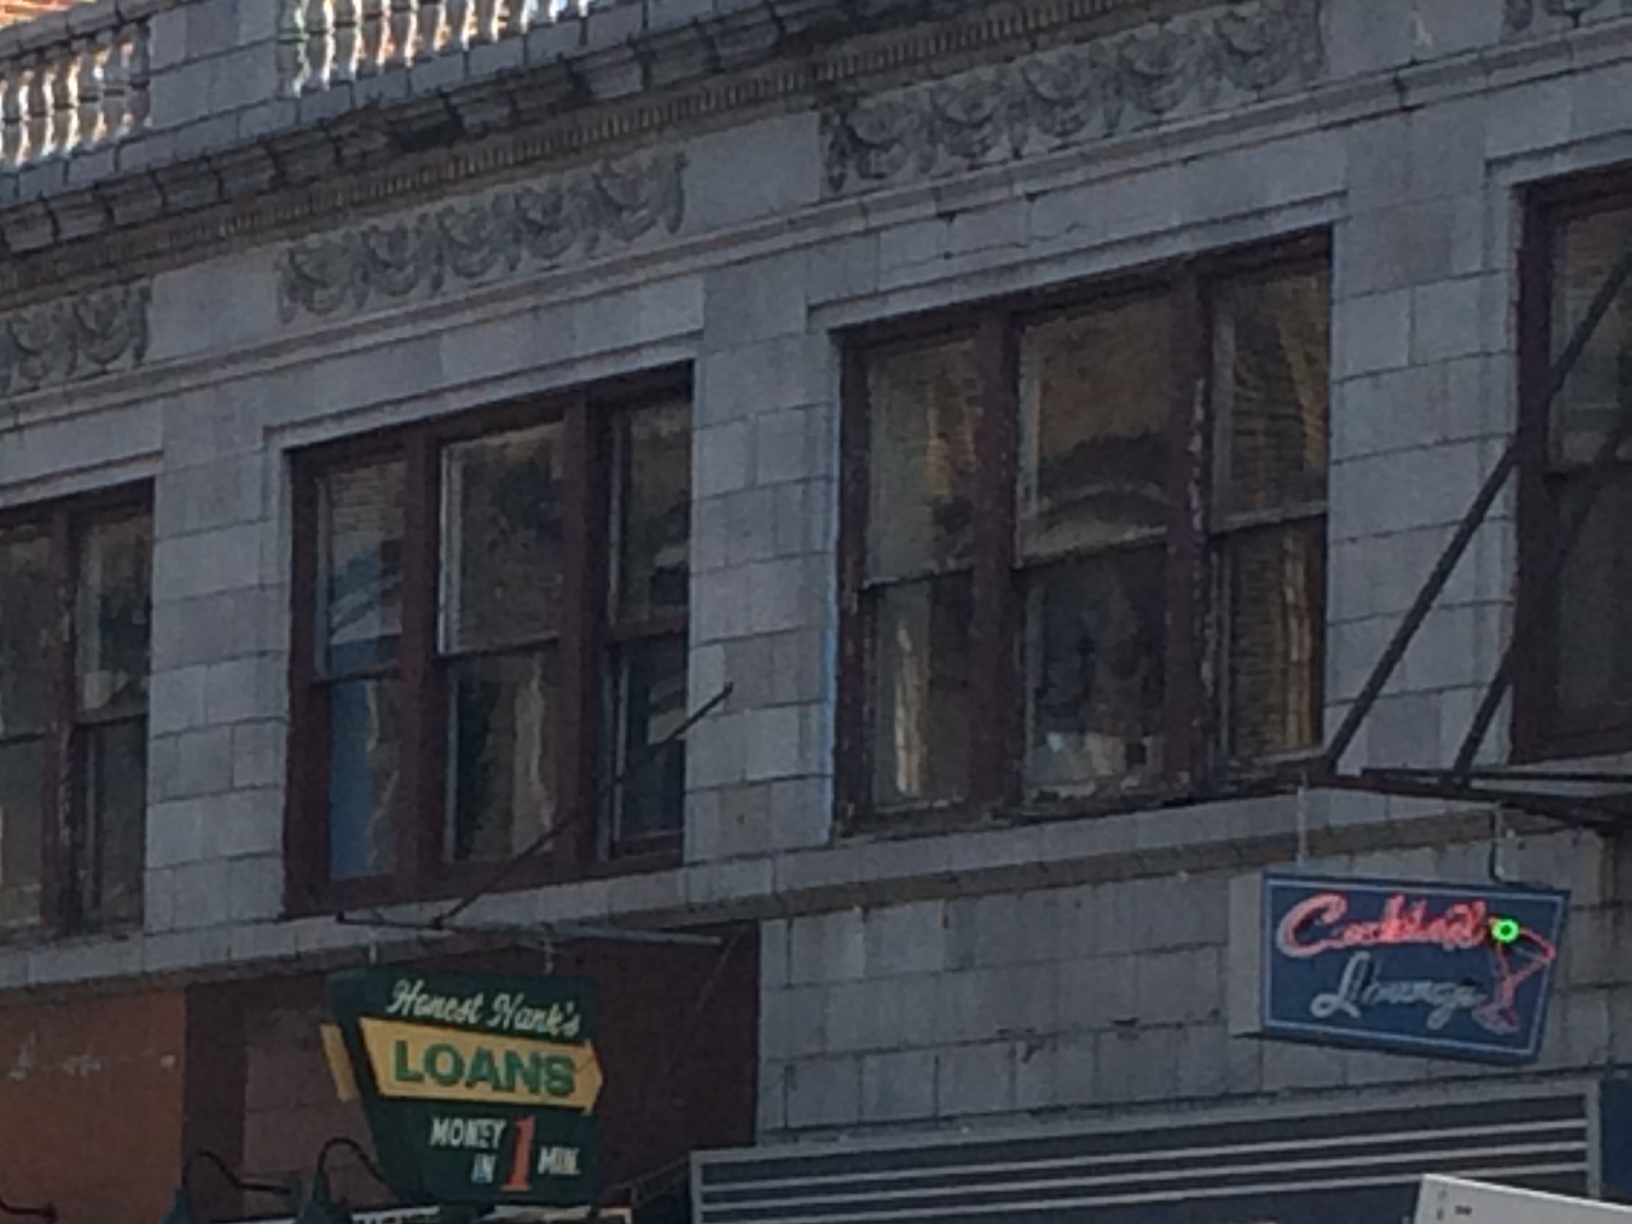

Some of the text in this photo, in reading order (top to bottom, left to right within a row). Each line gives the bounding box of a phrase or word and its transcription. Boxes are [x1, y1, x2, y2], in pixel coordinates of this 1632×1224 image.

[386, 979, 483, 1024] Honest
[393, 1040, 576, 1097] LOANS
[430, 1116, 507, 1149] MONEY
[501, 1115, 536, 1192] 1
